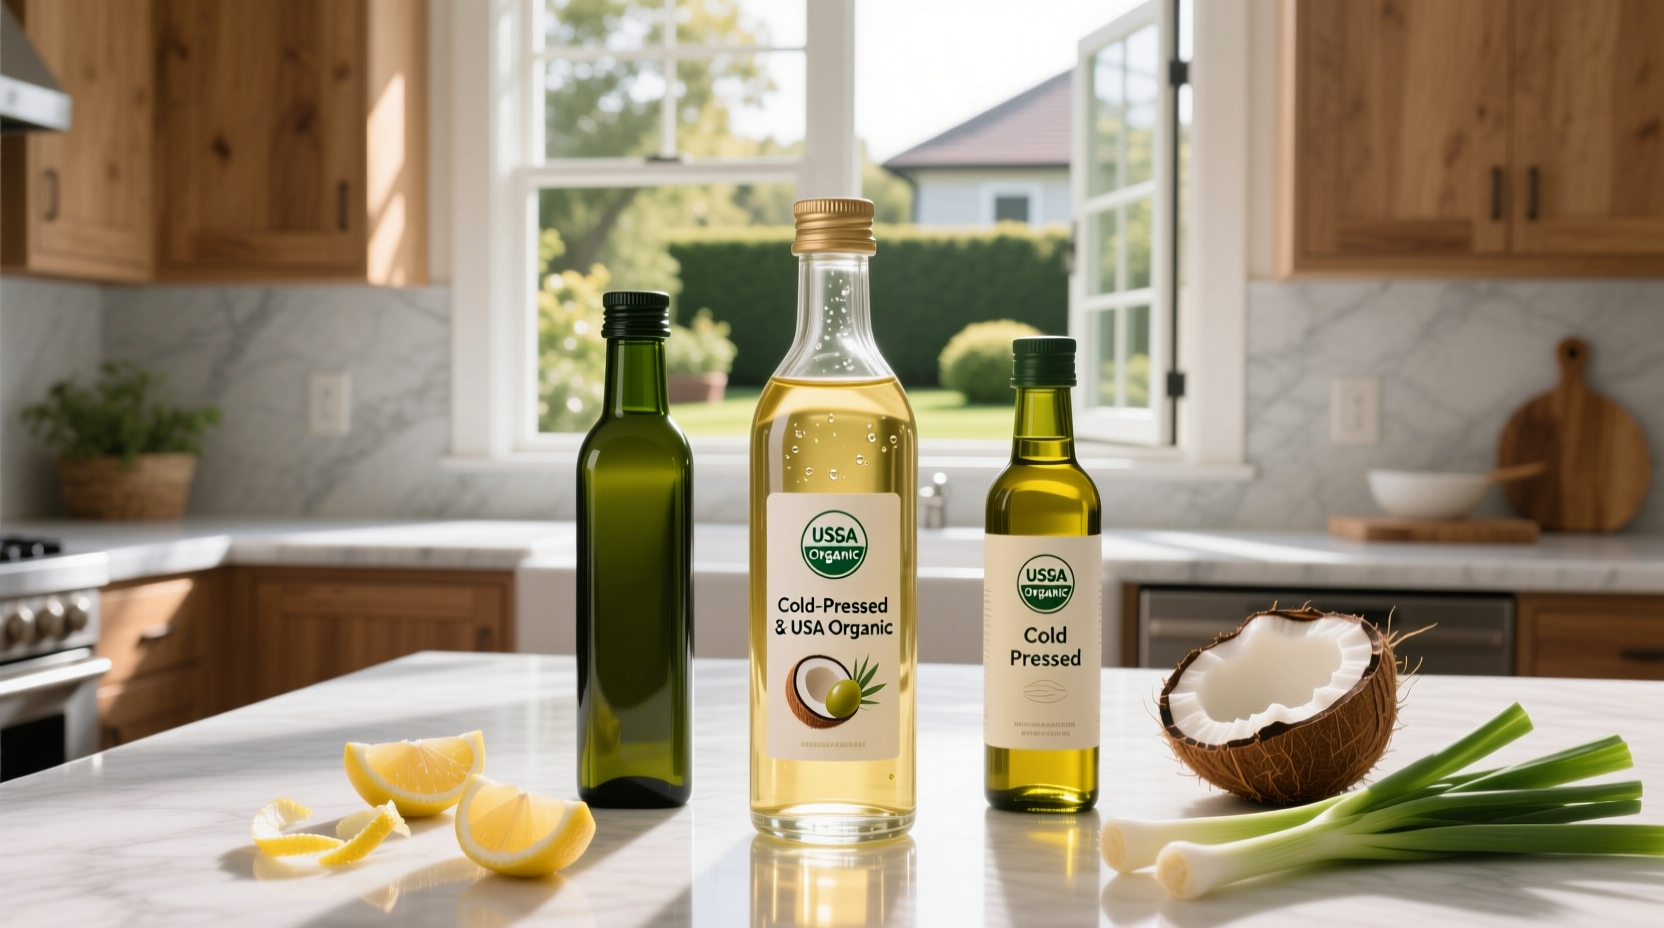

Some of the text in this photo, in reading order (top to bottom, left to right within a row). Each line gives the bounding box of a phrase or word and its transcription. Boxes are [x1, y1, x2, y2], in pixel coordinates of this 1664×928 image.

[812, 526, 858, 543] USSA
[778, 597, 887, 613] Cold-Pressed
[775, 619, 893, 640] & USA Organic
[1024, 626, 1067, 644] Cold
[1010, 648, 1081, 666] Pressed
